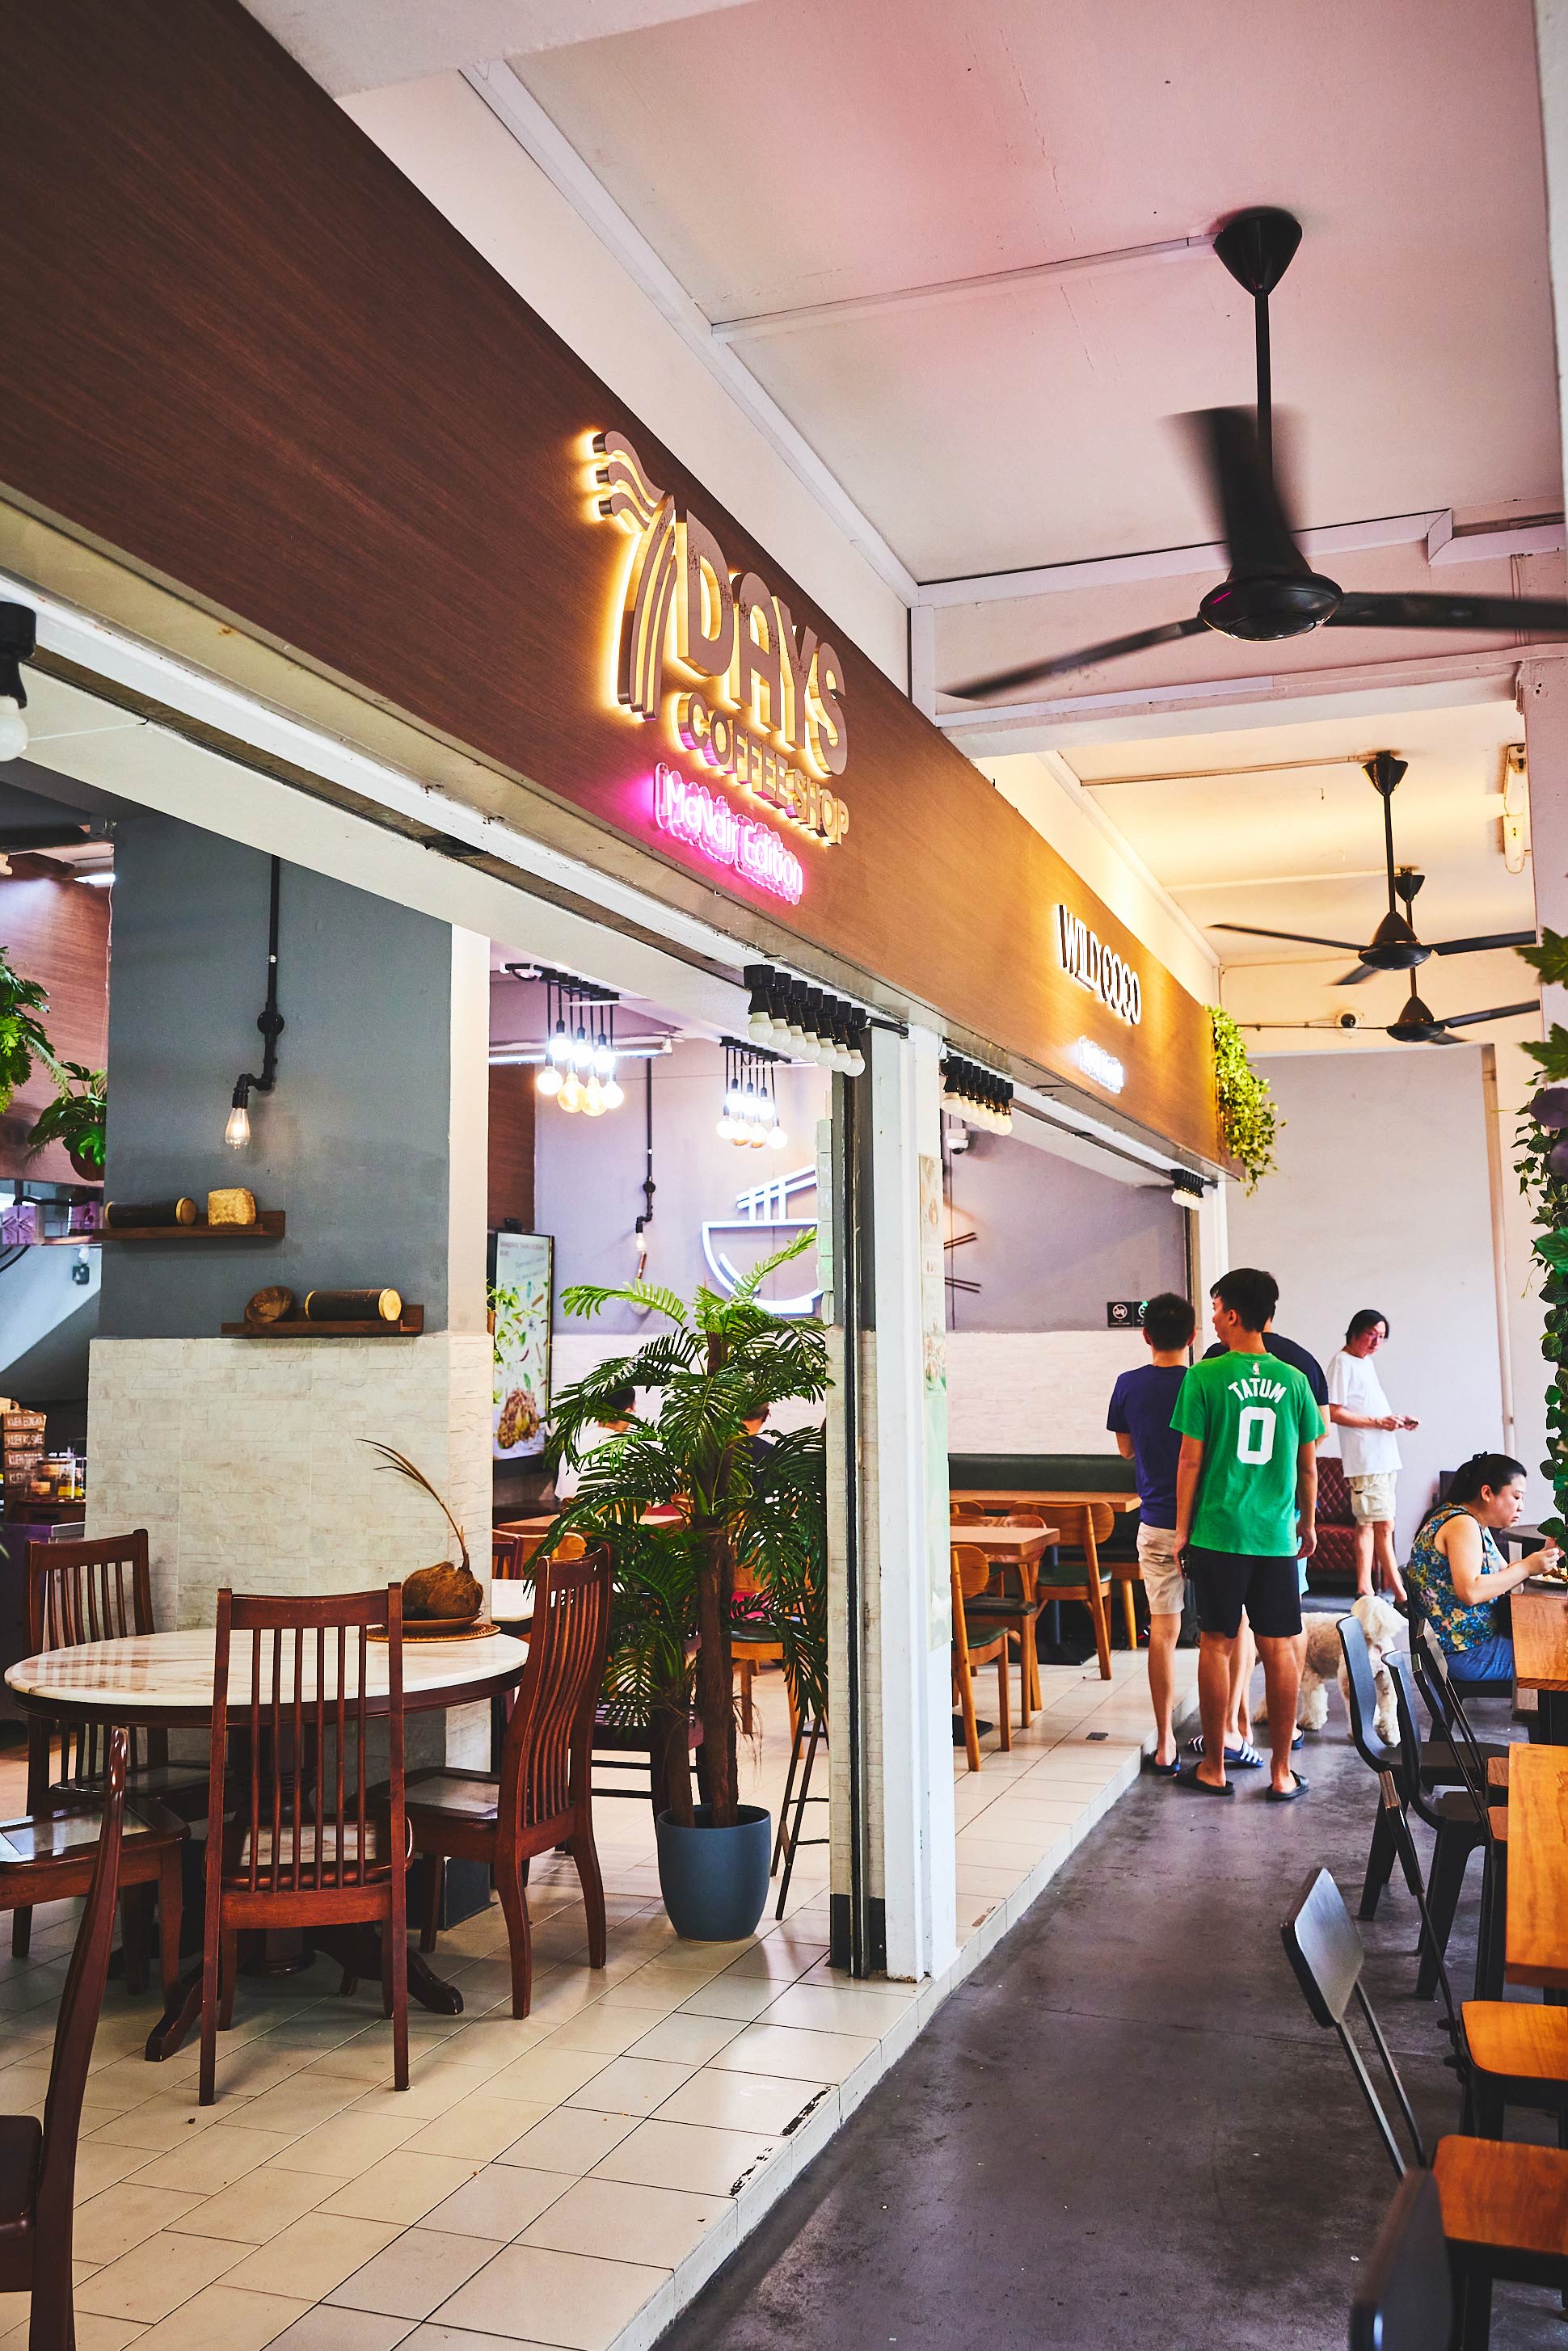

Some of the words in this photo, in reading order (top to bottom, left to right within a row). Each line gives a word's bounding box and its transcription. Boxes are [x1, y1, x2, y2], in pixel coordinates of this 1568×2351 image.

[677, 509, 847, 775] DAYS
[679, 692, 789, 808] COFFEE
[786, 769, 849, 845] SHOP
[666, 774, 740, 853] McNair
[744, 824, 803, 895] Edition
[1228, 1378, 1287, 1403] TATUM
[1237, 1406, 1276, 1464] 0
